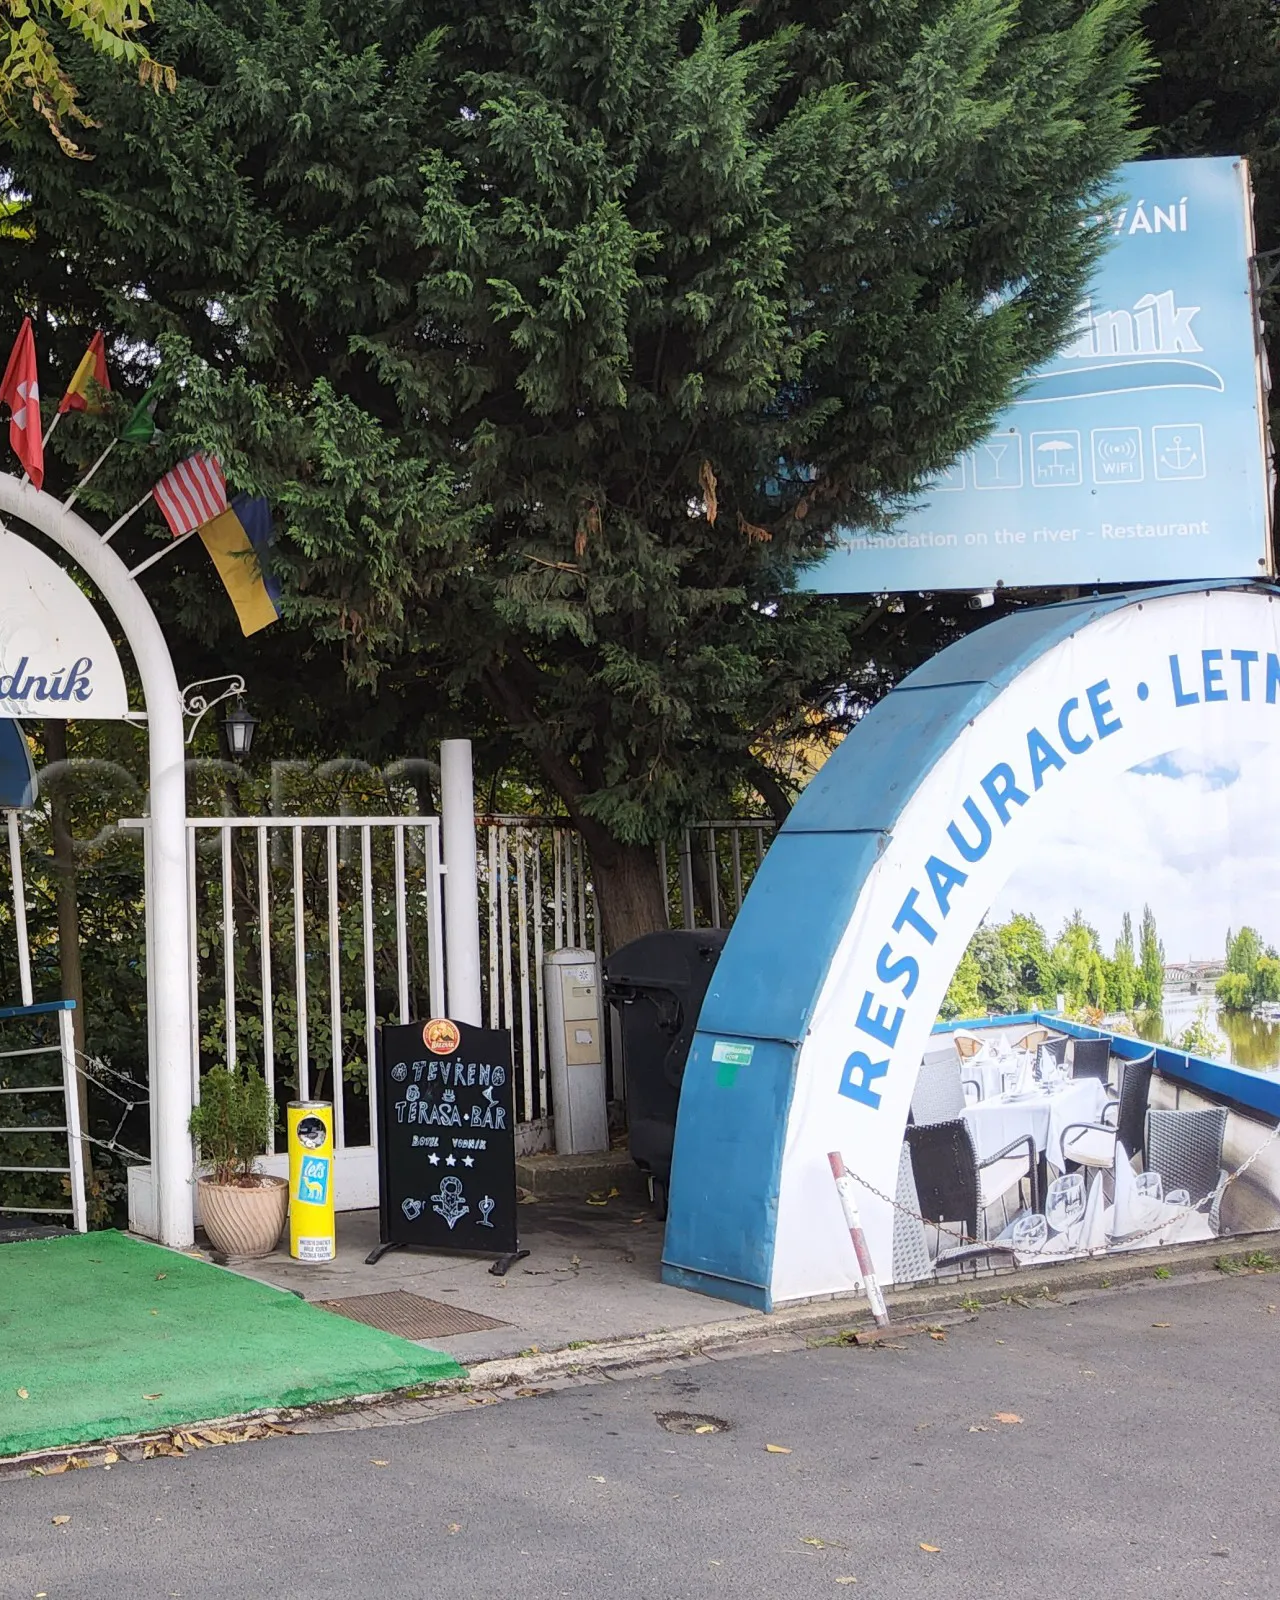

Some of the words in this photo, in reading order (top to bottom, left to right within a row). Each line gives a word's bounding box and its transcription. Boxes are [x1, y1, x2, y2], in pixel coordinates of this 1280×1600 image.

[1060, 290, 1205, 358] dník
[964, 533, 988, 545] on
[995, 528, 1027, 545] the
[1033, 527, 1080, 543] river
[1101, 519, 1210, 540] Restaurant
[838, 678, 1123, 1110] RESTAURACE
[395, 1101, 463, 1127] TERASA
[470, 1105, 506, 1130] BAR
